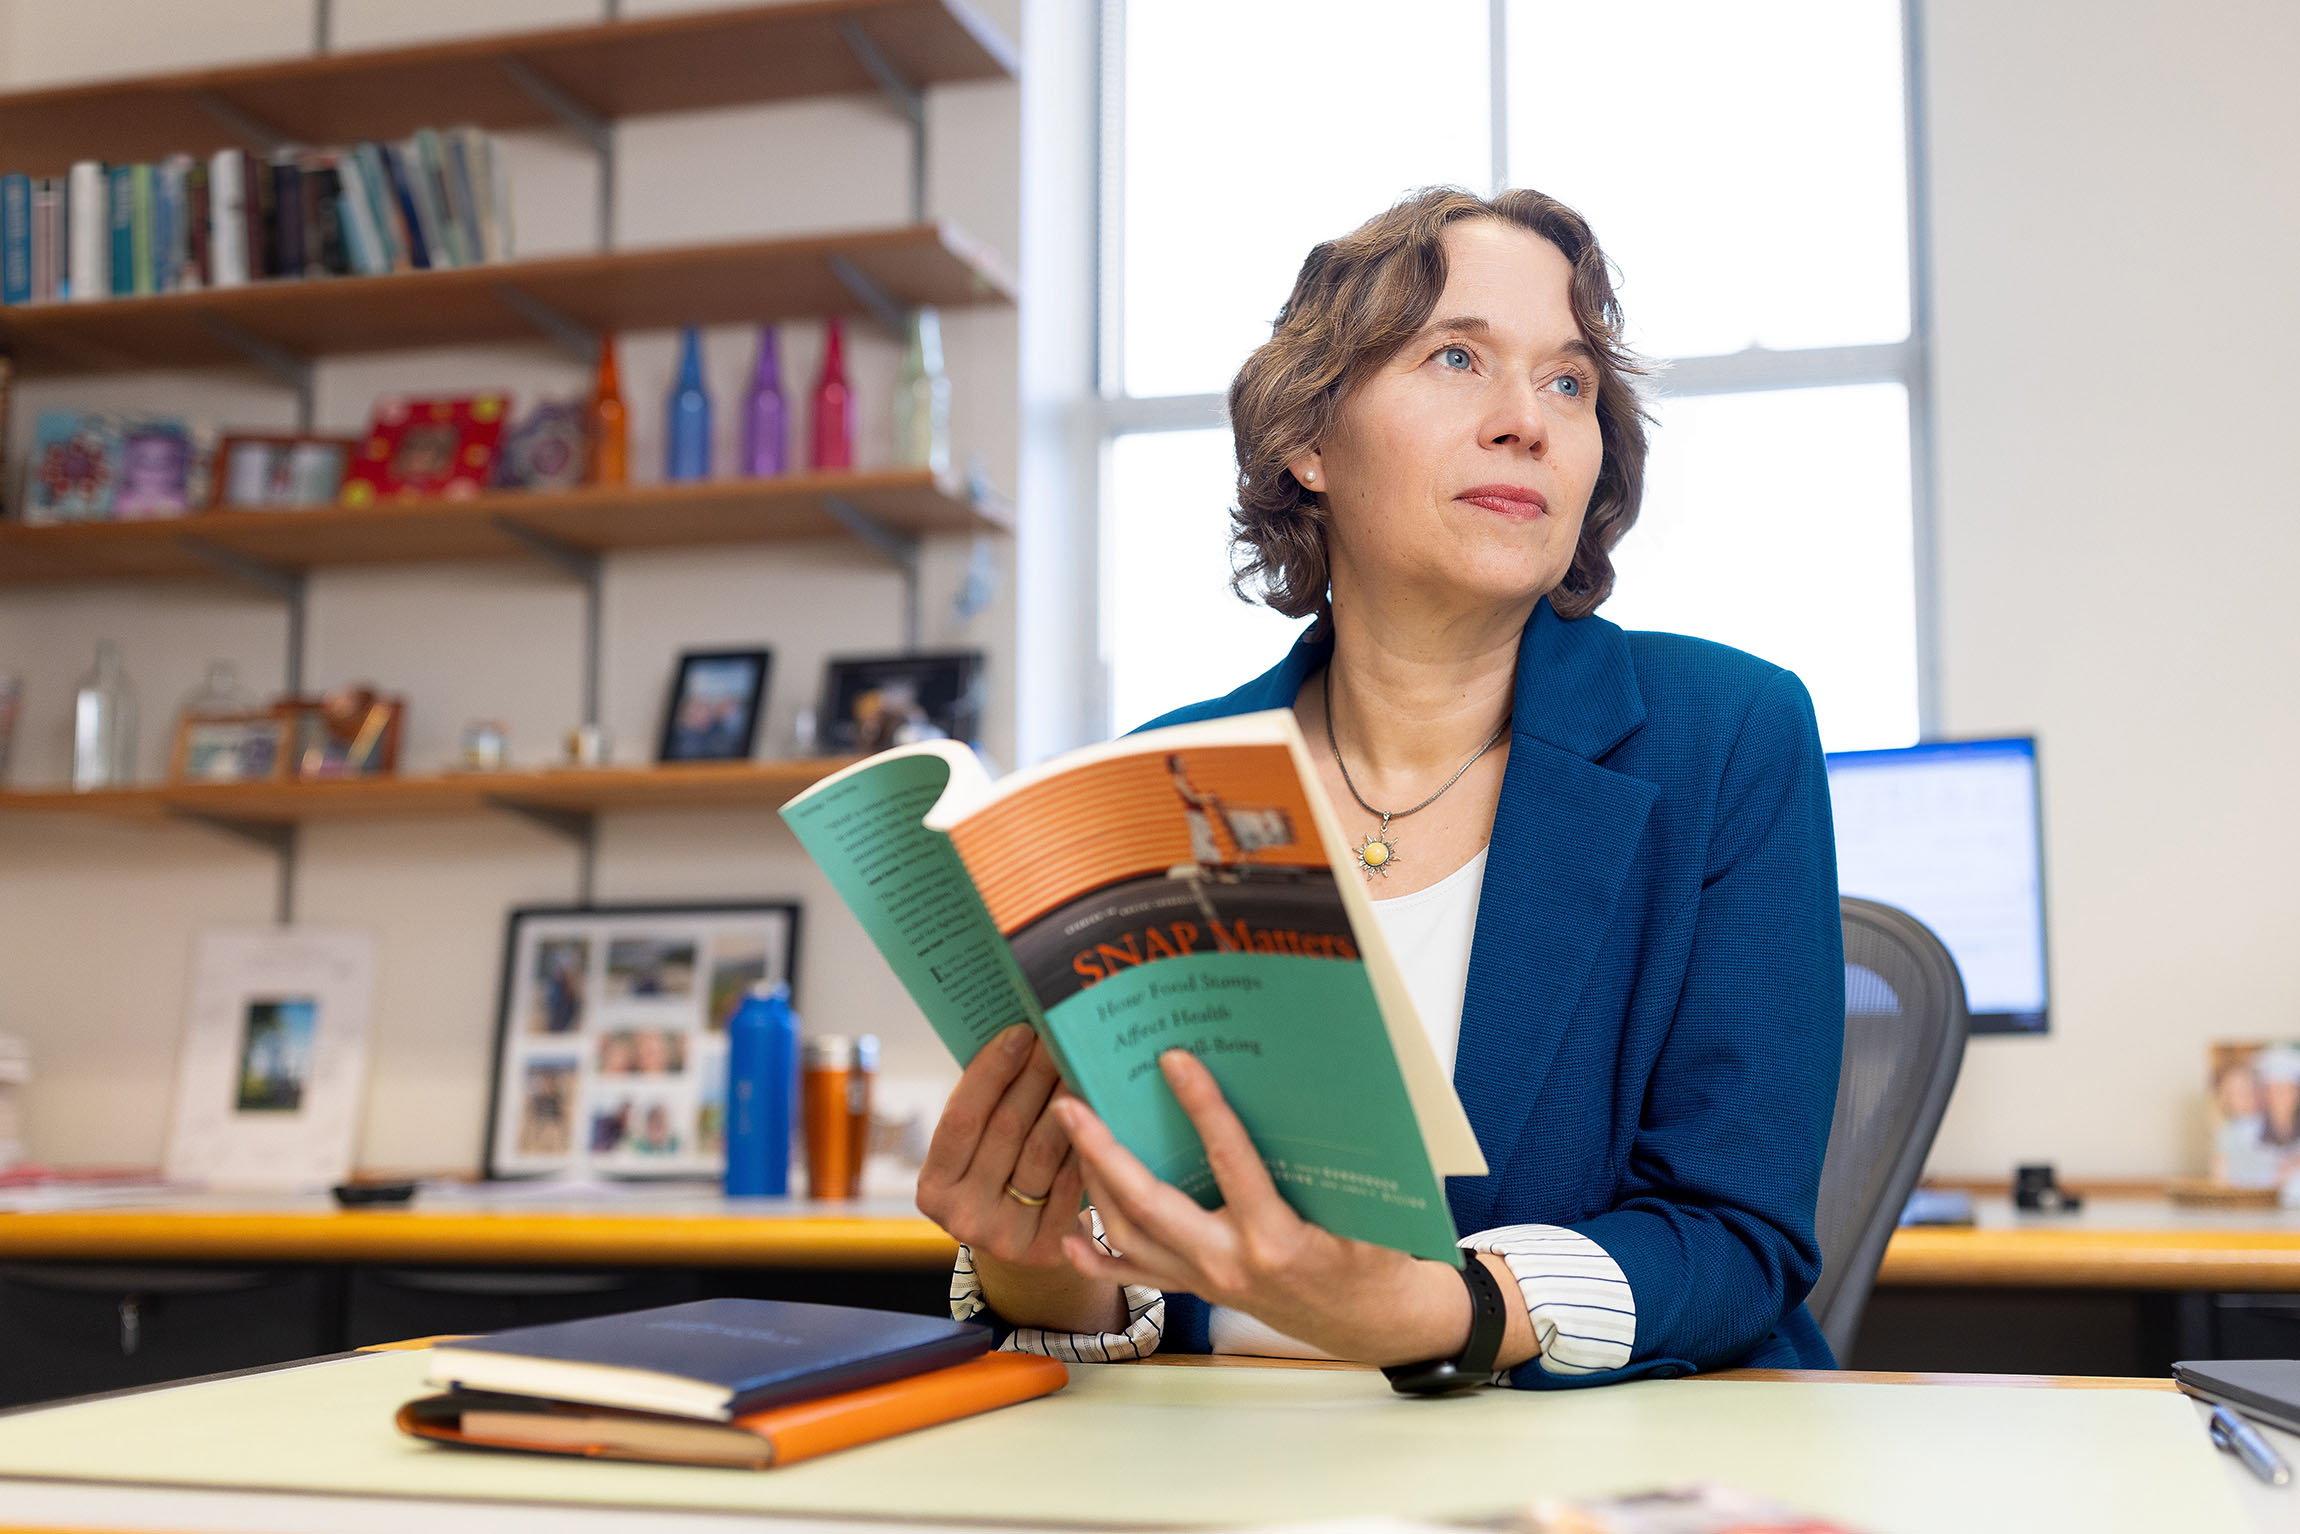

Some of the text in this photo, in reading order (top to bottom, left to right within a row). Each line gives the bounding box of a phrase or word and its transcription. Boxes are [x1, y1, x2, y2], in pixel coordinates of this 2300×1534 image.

[1072, 920, 1199, 990] SNAP
[1208, 917, 1358, 962] Matters
[1096, 972, 1263, 1022] How Food Stamps
[1114, 1004, 1232, 1052] Affect Health
